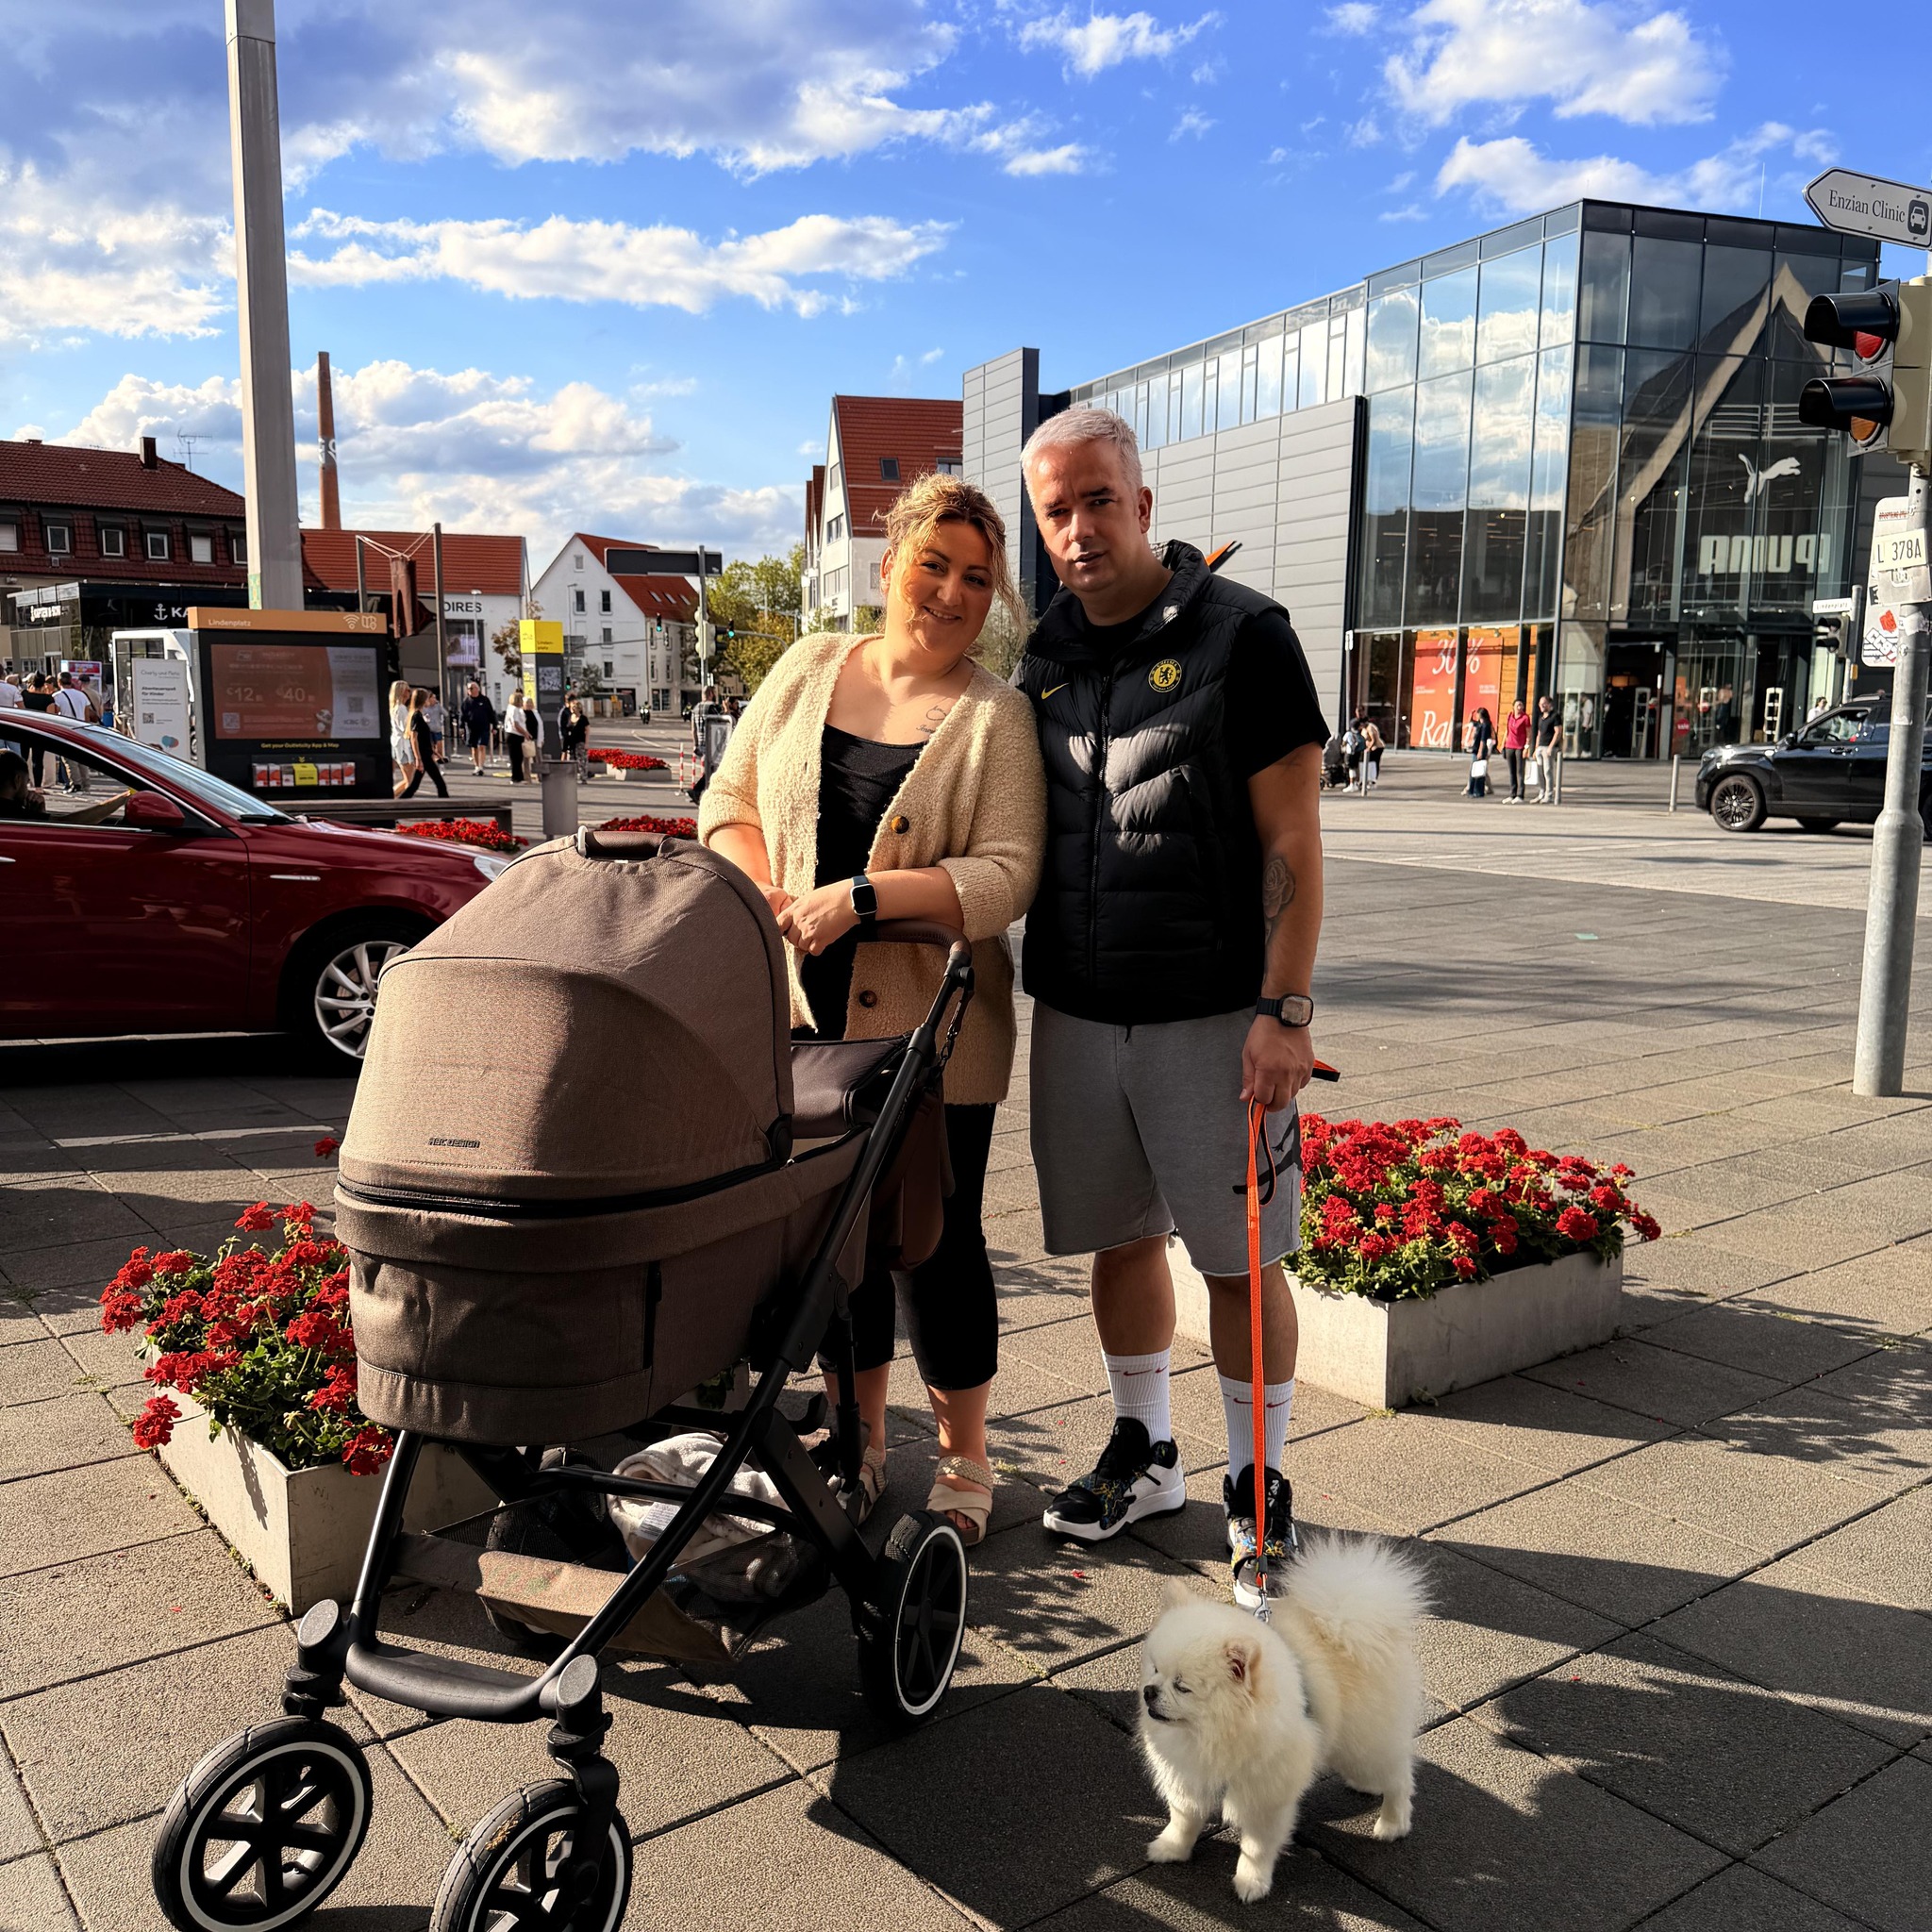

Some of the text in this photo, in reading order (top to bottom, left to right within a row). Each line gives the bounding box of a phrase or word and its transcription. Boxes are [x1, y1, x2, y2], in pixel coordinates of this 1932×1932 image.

[1828, 189, 1906, 224] Enzian Clinic
[1877, 538, 1922, 563] L 378A
[1816, 602, 1848, 610] Lindenplatz
[208, 618, 252, 628] Lindenplatz
